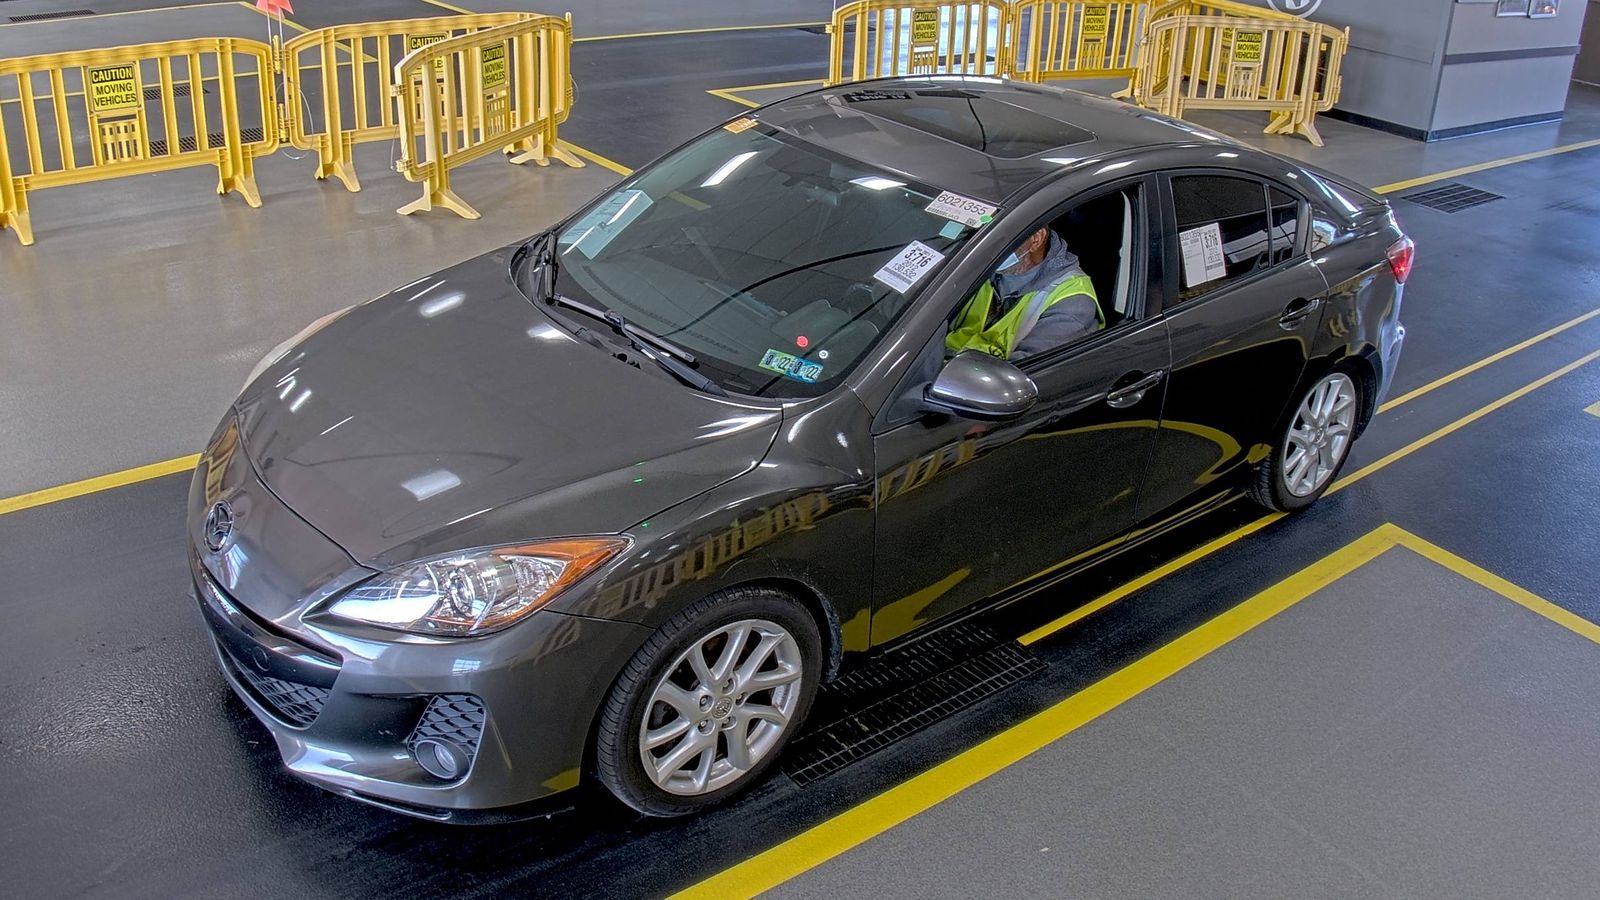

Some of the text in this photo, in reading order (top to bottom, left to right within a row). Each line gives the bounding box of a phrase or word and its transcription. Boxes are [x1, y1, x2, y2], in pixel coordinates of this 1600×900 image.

[915, 22, 936, 31] MOVING
[912, 31, 936, 39] VEHICLES
[1237, 32, 1262, 42] CAUTION
[1237, 43, 1260, 51] MOVING
[1235, 51, 1260, 60] VEHICLES
[484, 60, 504, 74] MOVING
[91, 67, 133, 83] CAUTION
[96, 82, 133, 95] MOVING
[94, 92, 137, 107] VEHICLES
[937, 193, 989, 216] 6021355
